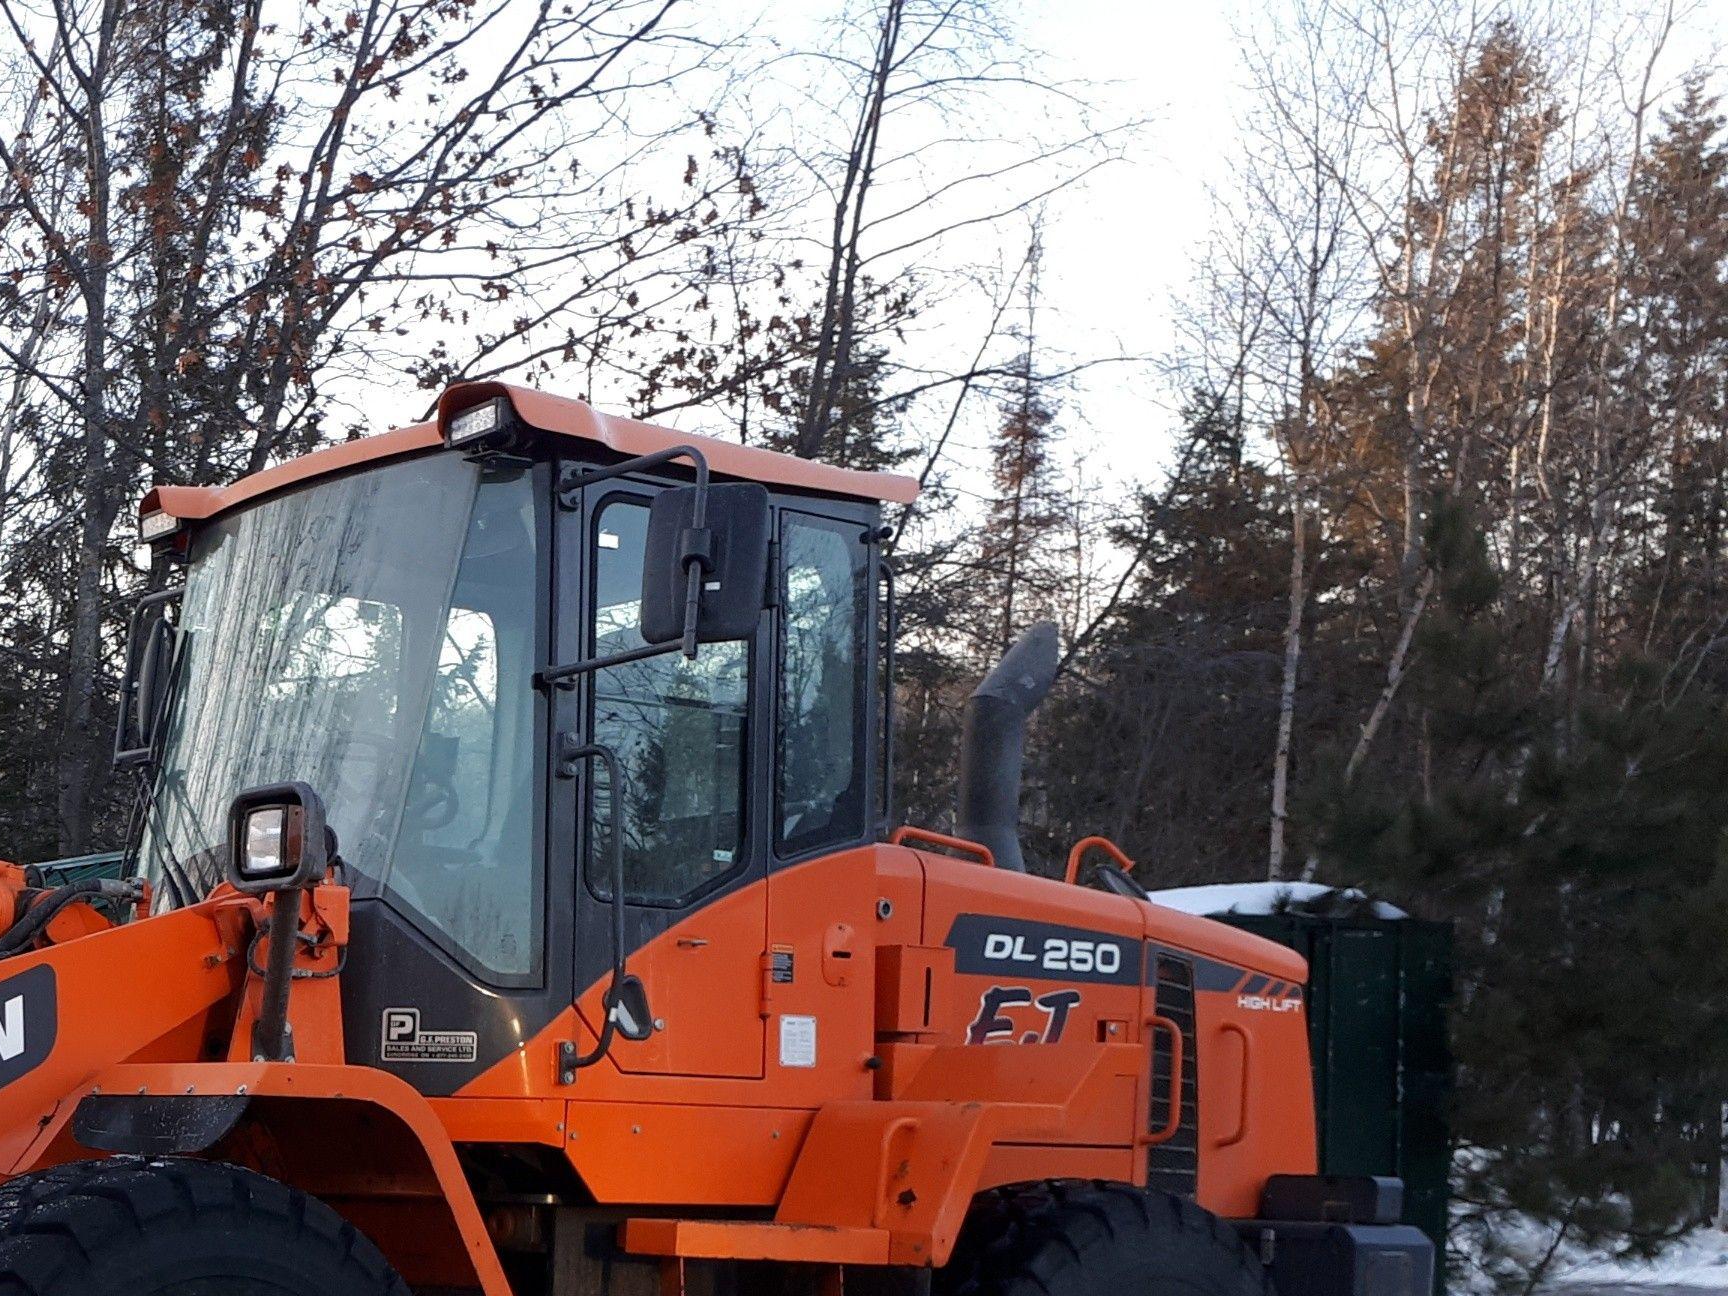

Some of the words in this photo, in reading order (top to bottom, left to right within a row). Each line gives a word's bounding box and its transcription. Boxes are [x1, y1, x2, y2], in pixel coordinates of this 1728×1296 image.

[984, 933, 1037, 962] DL
[1042, 938, 1121, 974] 250
[1237, 995, 1271, 1010] HIGH
[1272, 997, 1302, 1013] LIFT
[434, 1035, 473, 1044] PRESTON
[427, 1045, 457, 1053] SERVICE
